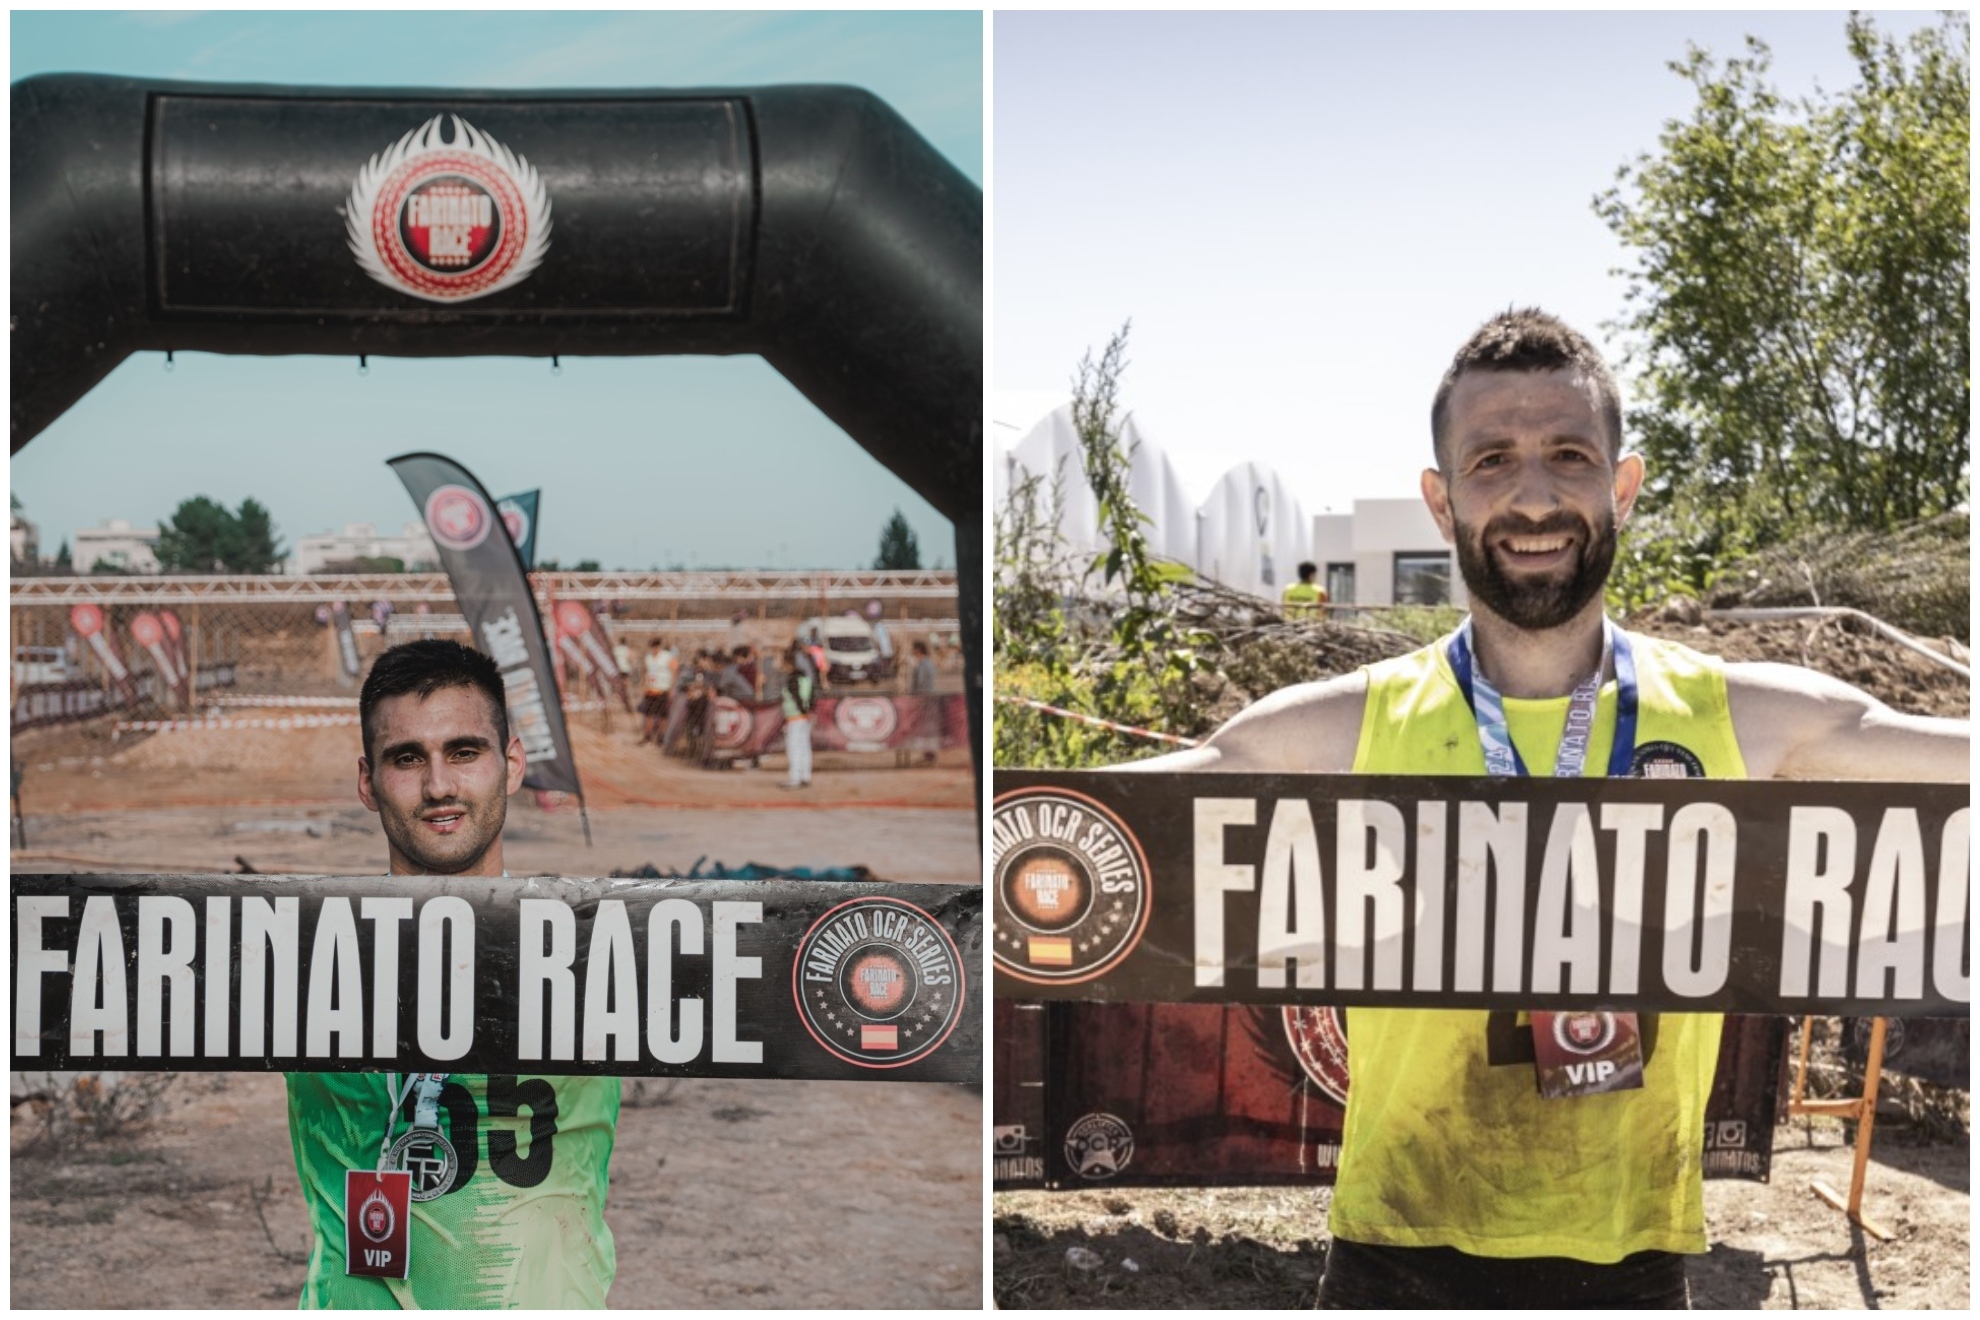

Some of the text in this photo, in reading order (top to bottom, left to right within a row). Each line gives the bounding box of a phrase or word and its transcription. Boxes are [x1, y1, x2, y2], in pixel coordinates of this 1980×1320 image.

[1038, 803, 1083, 843] OCR
[1078, 823, 1135, 893] SERIES
[1194, 798, 1737, 998] FARINATO
[15, 895, 763, 1064] FARINATO RACE
[806, 910, 951, 986] FARINATO OCR SERIES
[1565, 1061, 1616, 1086] VIP
[364, 1248, 392, 1268] VIP
